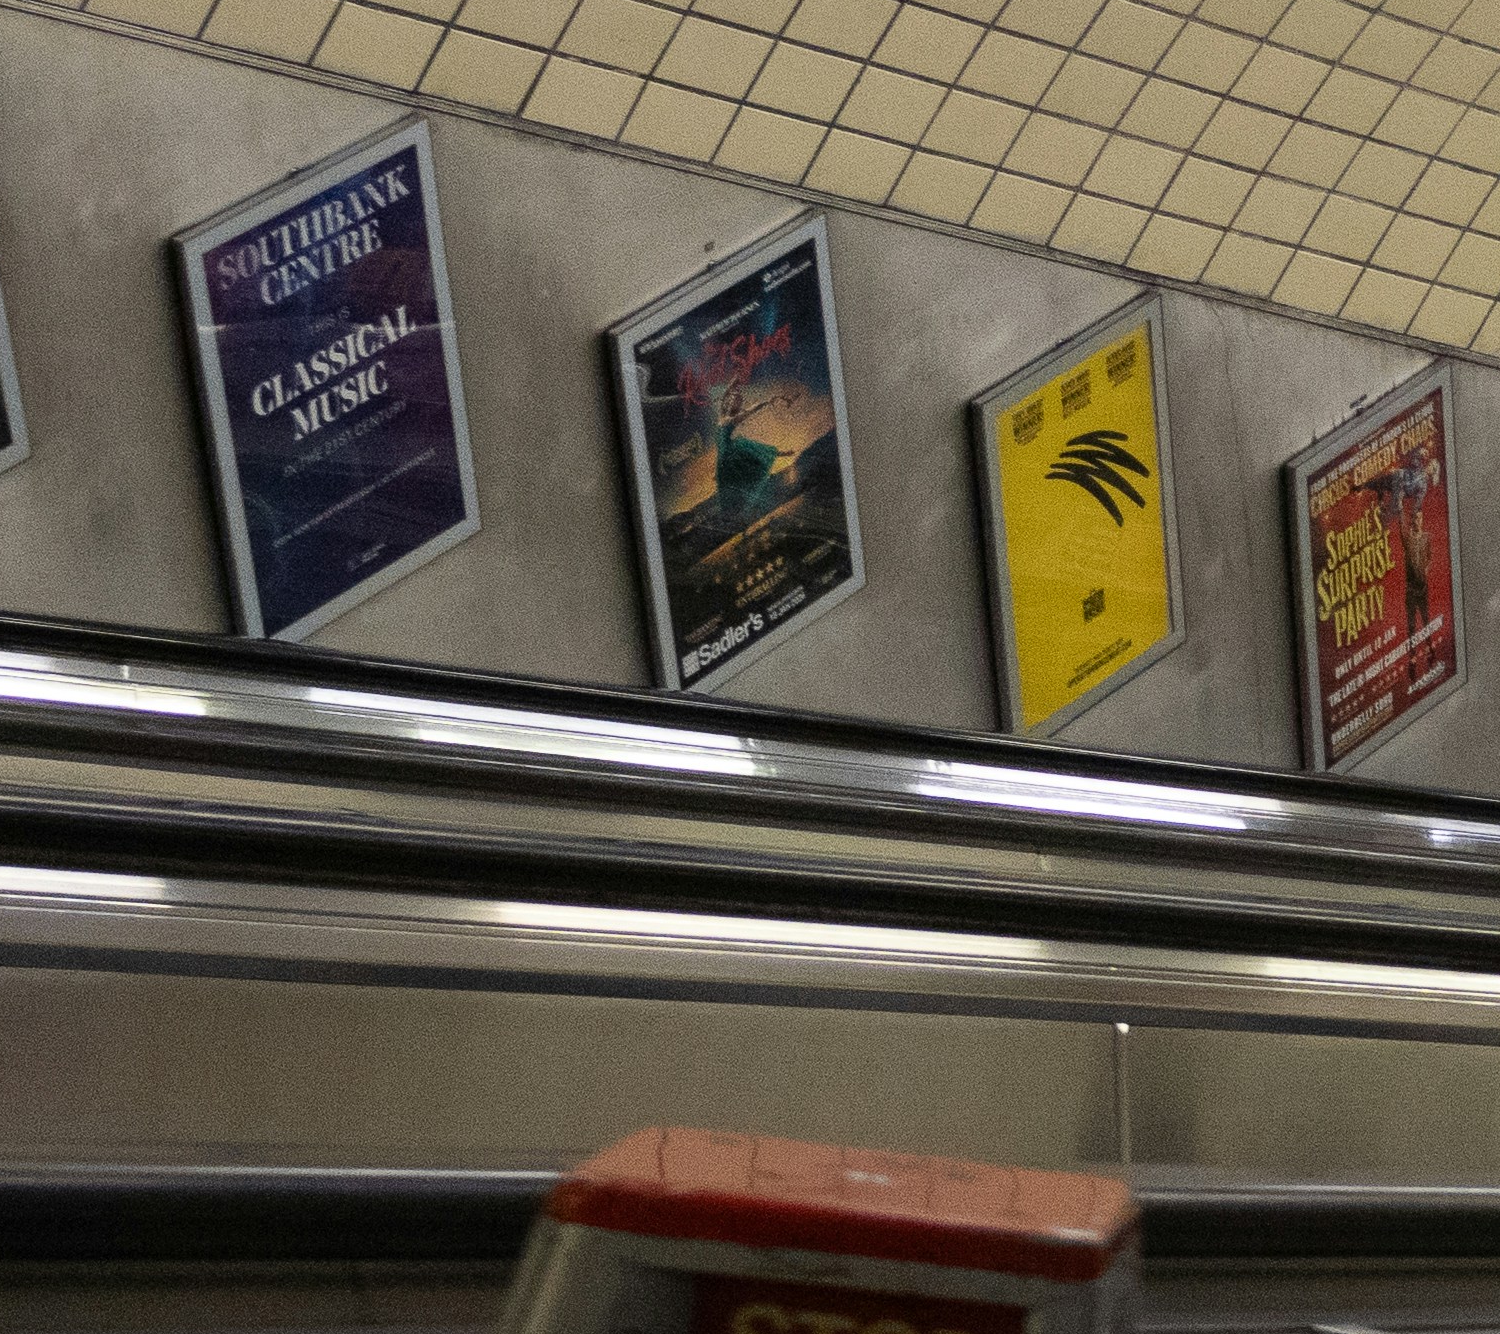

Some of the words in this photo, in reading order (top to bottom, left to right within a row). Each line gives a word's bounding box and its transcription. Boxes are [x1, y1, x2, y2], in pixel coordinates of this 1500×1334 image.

[217, 164, 411, 292] SOUTHBANK
[259, 218, 384, 307] CENTRE
[250, 304, 417, 418] CLASSICAL
[289, 360, 389, 442] MUSIC
[1317, 530, 1396, 623] SURPRISE
[1327, 501, 1383, 571] SOPHIE'S
[698, 611, 764, 667] Sadler's
[1334, 585, 1387, 650] PARTY
